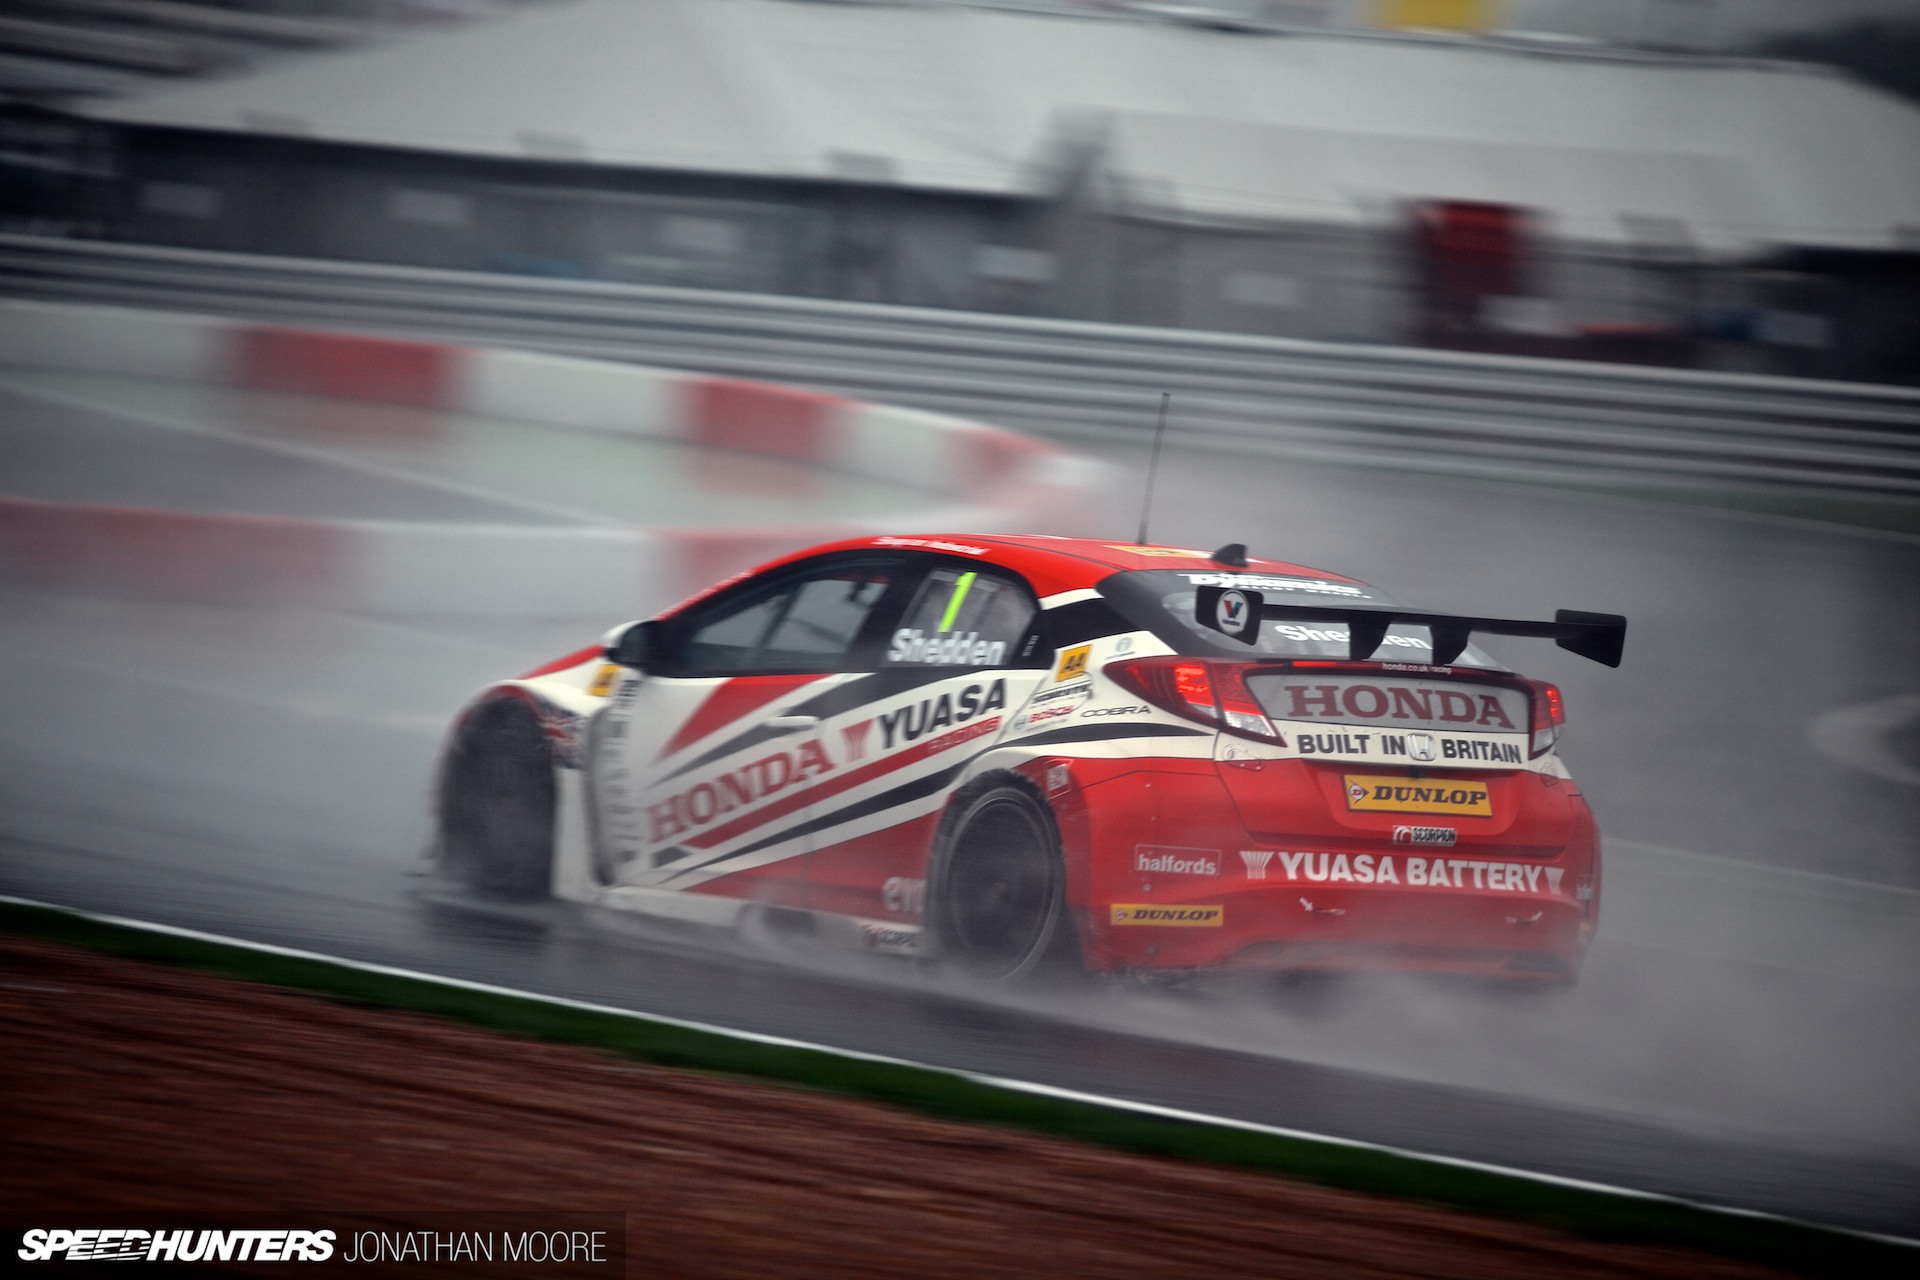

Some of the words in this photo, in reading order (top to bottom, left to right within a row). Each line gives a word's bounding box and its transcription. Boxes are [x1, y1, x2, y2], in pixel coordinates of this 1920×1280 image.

[937, 571, 977, 633] 1
[888, 628, 1006, 665] Shedden
[1274, 624, 1433, 650] Sheen
[878, 678, 1007, 749] YUASA
[1080, 705, 1151, 718] COBRA
[1284, 684, 1516, 730] HONDA
[927, 716, 1000, 750] RACING
[1297, 733, 1371, 756] BUILT
[1381, 734, 1407, 755] IN
[1441, 738, 1522, 764] BRITAIN
[648, 739, 836, 844] HONDA
[1372, 785, 1487, 805] DUNLOP
[1412, 827, 1456, 843] SCORPION
[1137, 853, 1217, 875] halfords
[1278, 851, 1400, 885] YUASA
[1406, 857, 1543, 893] BATTERY
[1132, 909, 1219, 921] DUNLOP
